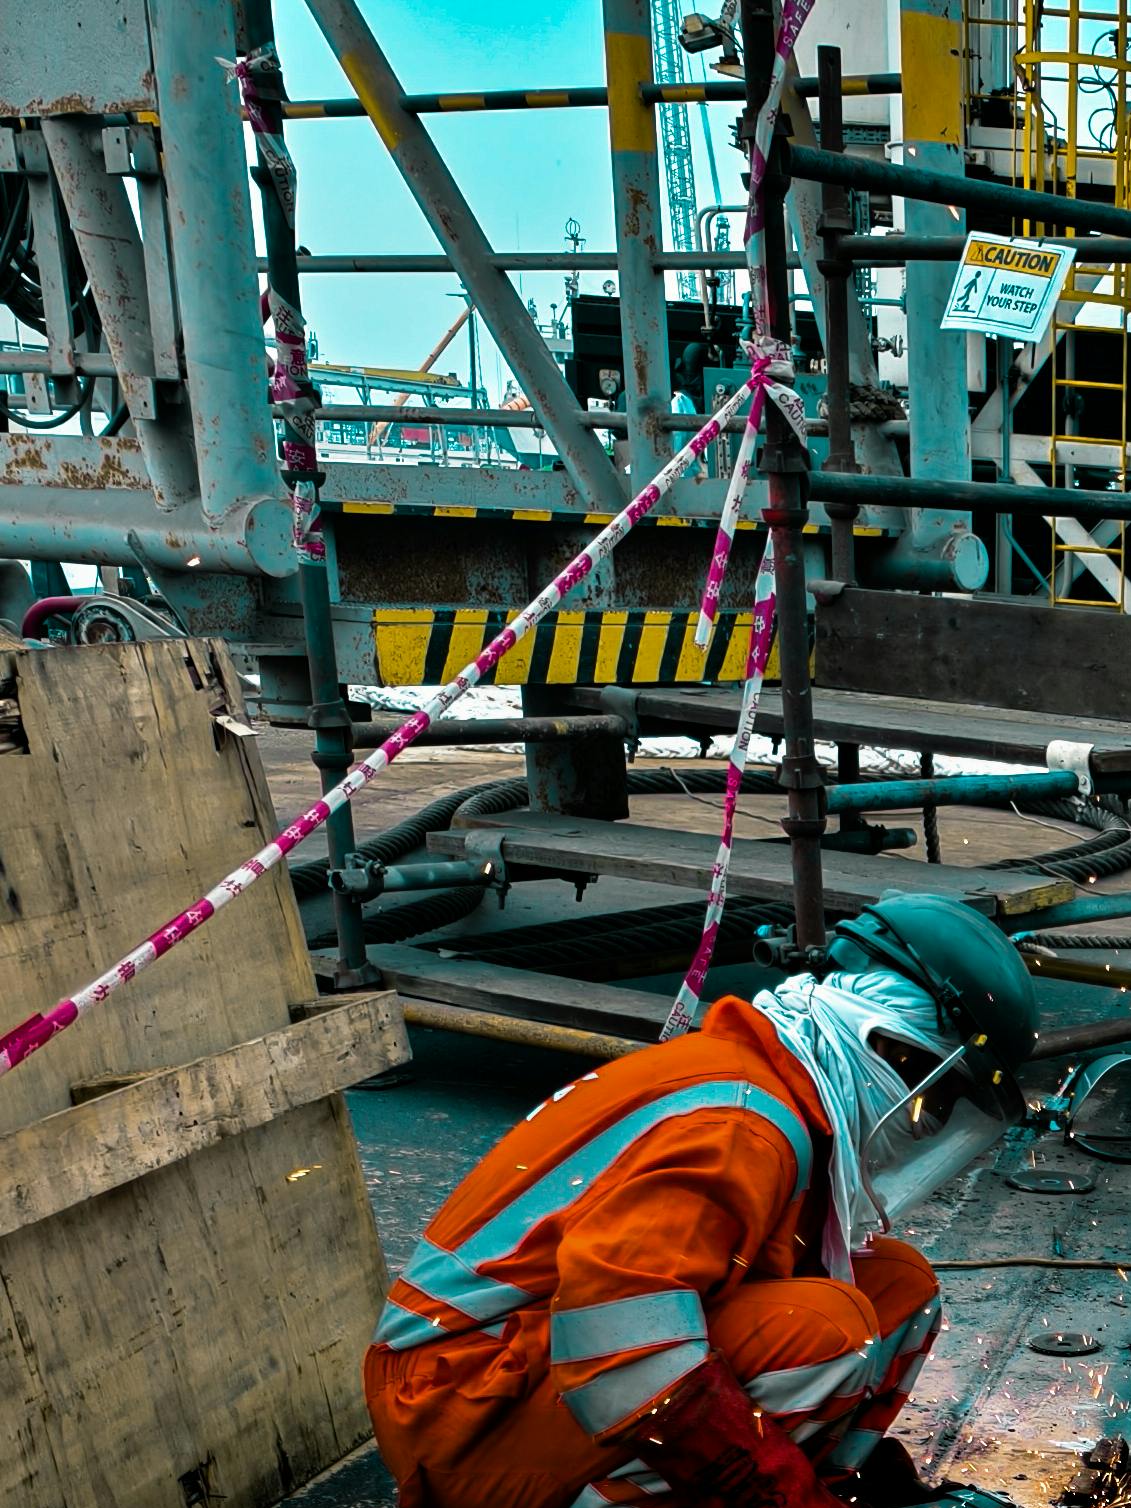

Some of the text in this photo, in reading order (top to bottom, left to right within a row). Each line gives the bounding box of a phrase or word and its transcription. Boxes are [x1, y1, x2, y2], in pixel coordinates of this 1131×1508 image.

[783, 1, 811, 47] SAFE
[984, 247, 1053, 272] CAUTION
[986, 295, 1037, 314] YOUR STEP
[1000, 283, 1034, 298] WATCH
[738, 692, 759, 752] CAUTION
[658, 1001, 685, 1040] CAUTI
